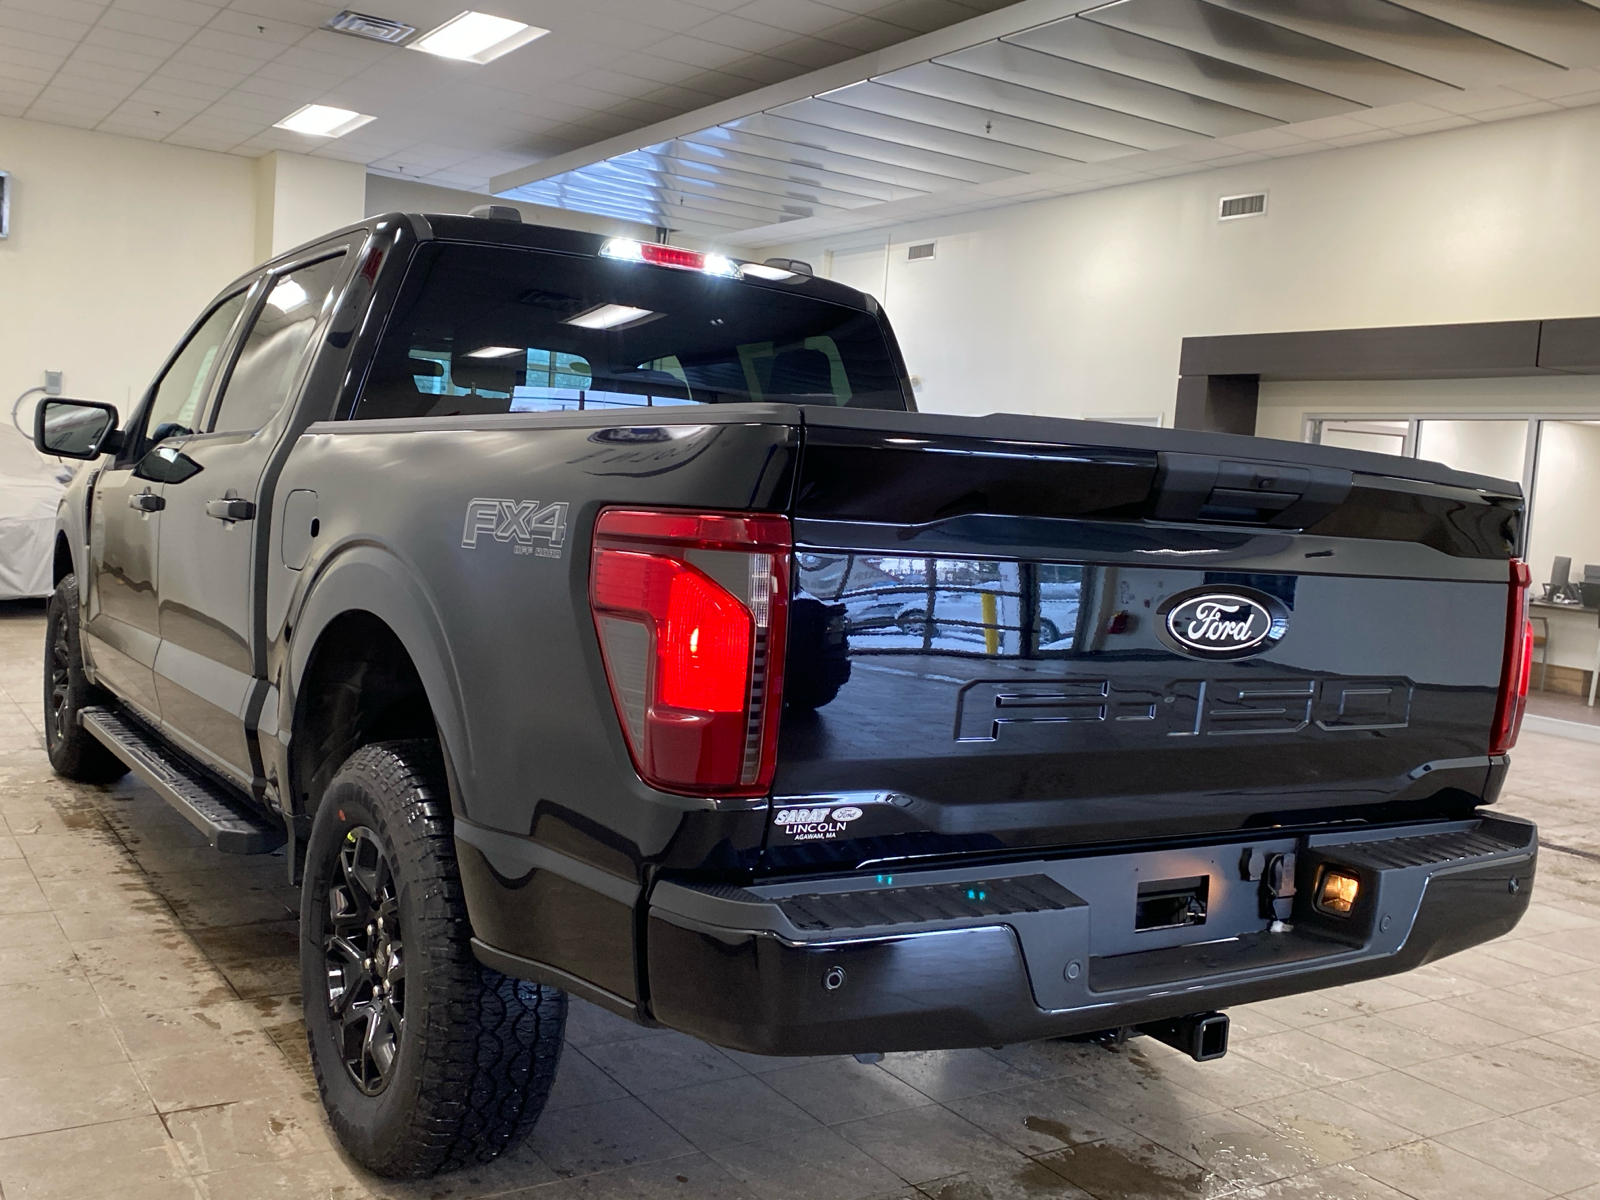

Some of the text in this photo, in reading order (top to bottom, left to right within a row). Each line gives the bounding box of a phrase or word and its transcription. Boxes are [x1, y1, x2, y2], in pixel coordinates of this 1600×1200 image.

[461, 497, 570, 549] FX4
[1187, 602, 1255, 640] Ford
[953, 676, 1416, 743] F-150
[774, 808, 831, 826] SARAT
[785, 822, 847, 834] LINCOLN
[794, 832, 825, 841] AGAWAM,
